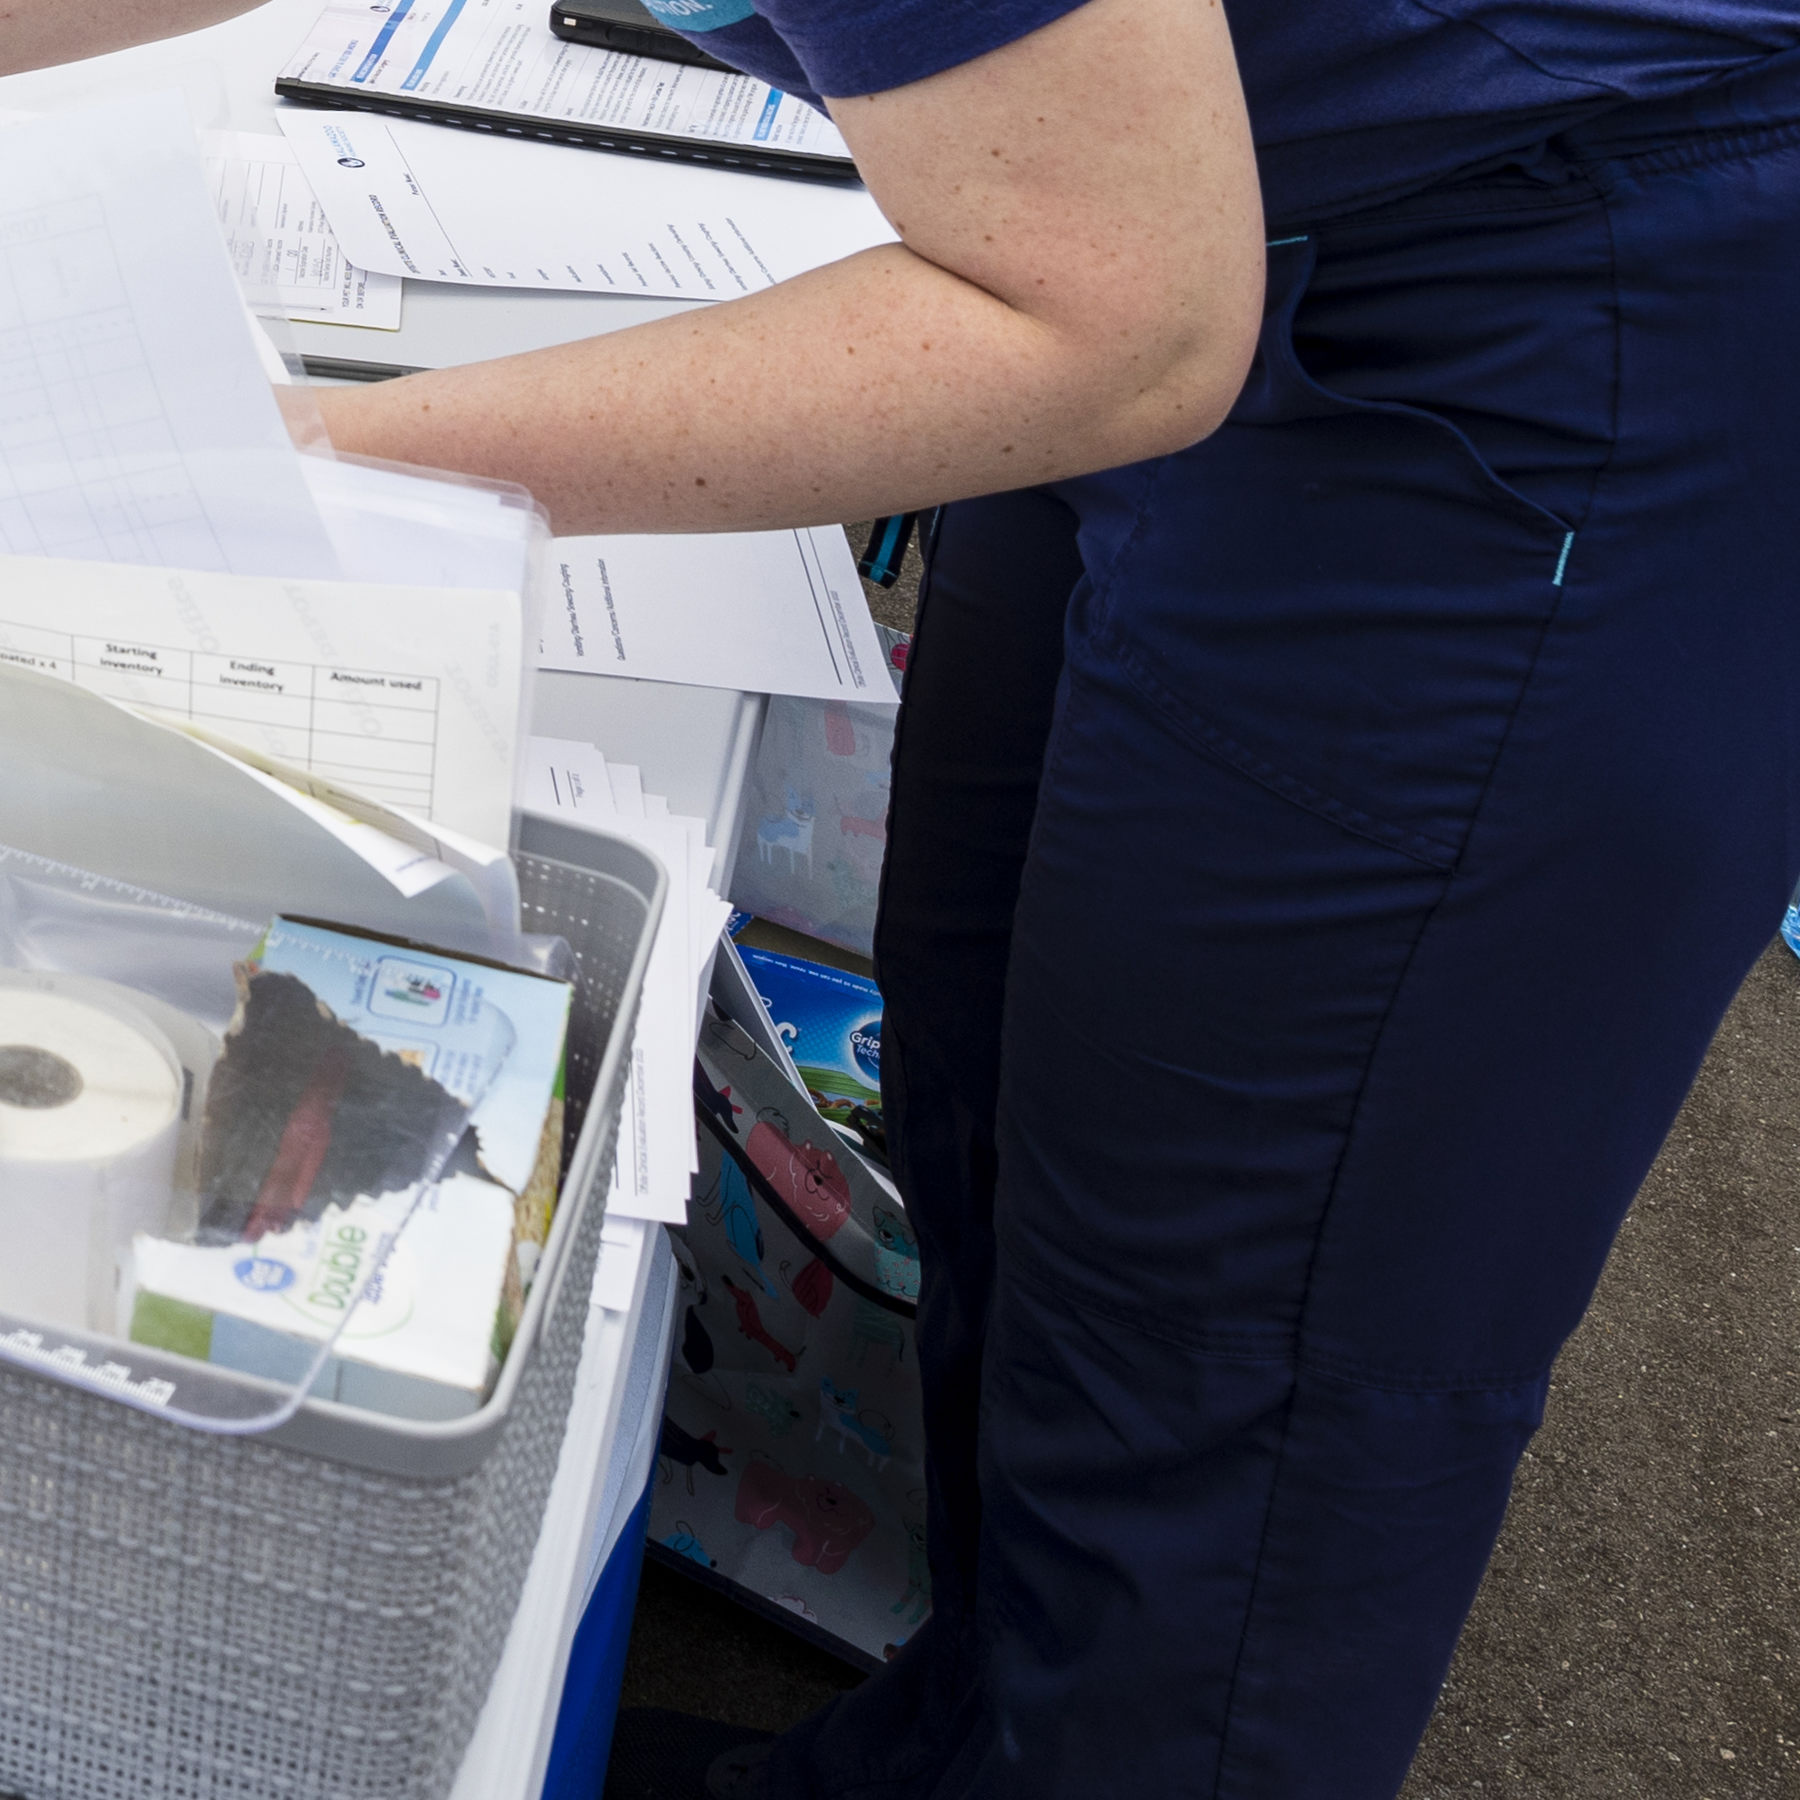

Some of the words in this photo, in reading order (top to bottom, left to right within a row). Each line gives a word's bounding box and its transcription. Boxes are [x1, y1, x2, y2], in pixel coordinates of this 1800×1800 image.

[368, 194, 388, 213] RECORD
[378, 212, 404, 241] EVALUATION
[391, 241, 413, 260] CLINICAL
[357, 282, 365, 296] BEFORE
[106, 643, 158, 661] Starting
[100, 657, 164, 676] inventory
[229, 660, 276, 677] Ending
[219, 675, 285, 693] inventory
[329, 671, 386, 688] Amount
[388, 678, 423, 691] used
[307, 1226, 367, 1310] Double
